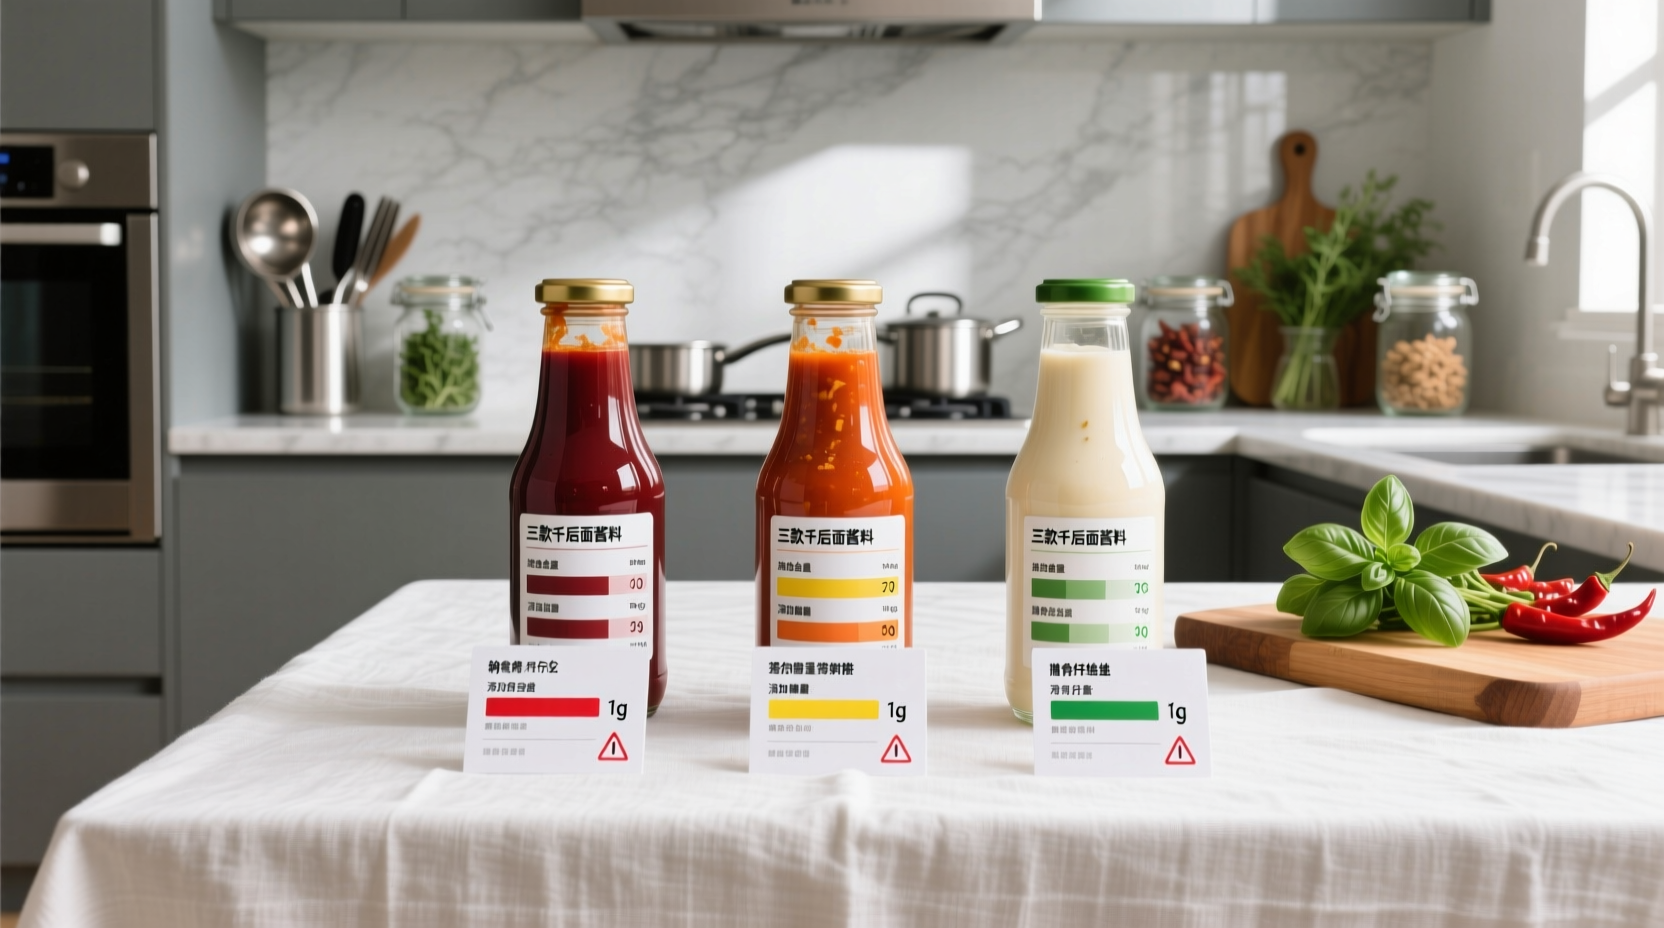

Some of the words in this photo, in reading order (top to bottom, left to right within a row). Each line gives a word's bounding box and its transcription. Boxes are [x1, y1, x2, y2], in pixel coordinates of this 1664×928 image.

[526, 524, 623, 543] 三款千后面酱料
[777, 528, 874, 546] 三款千后面酱料
[1031, 528, 1127, 546] 三款千后面酱料
[608, 699, 628, 721] 1g
[887, 701, 907, 723] 1g
[1168, 702, 1187, 725] 1g
